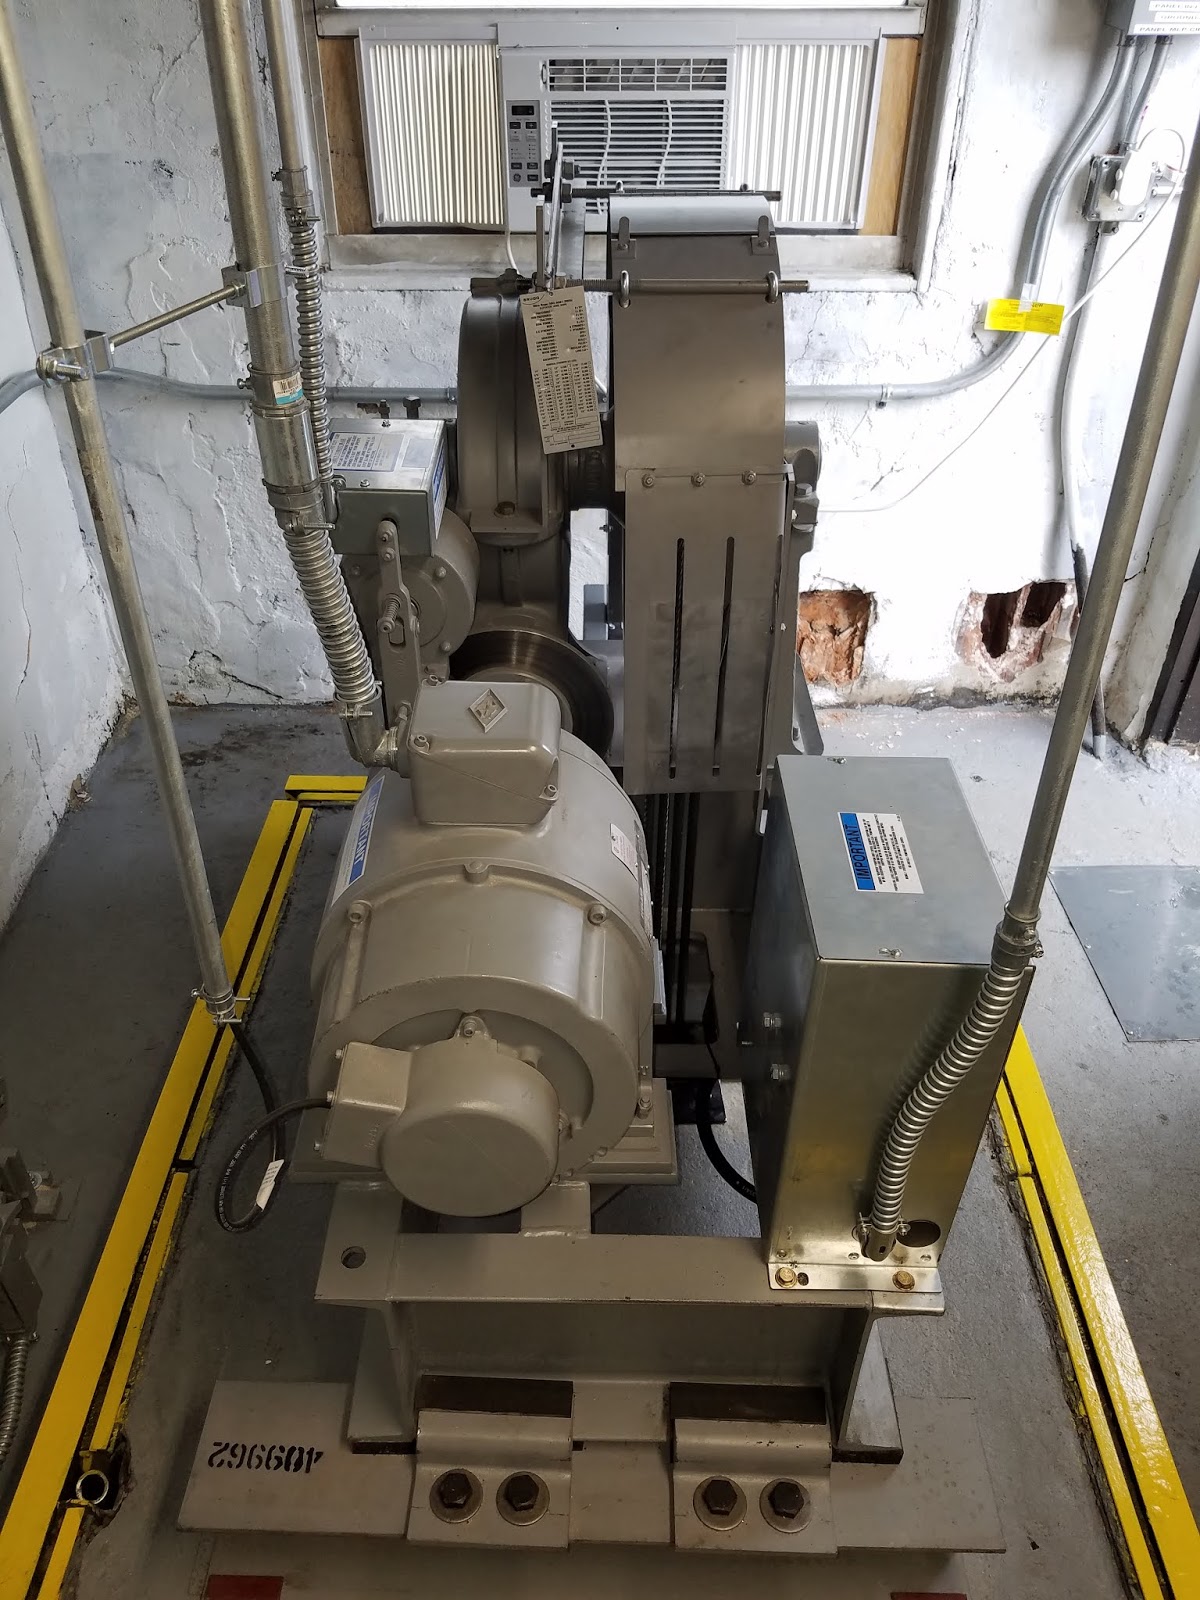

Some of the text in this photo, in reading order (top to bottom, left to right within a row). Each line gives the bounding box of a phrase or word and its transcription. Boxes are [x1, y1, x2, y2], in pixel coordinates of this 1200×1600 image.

[354, 794, 378, 865] IMPORTANT
[843, 823, 872, 881] IMPORTANT
[207, 1441, 324, 1474] 409962
